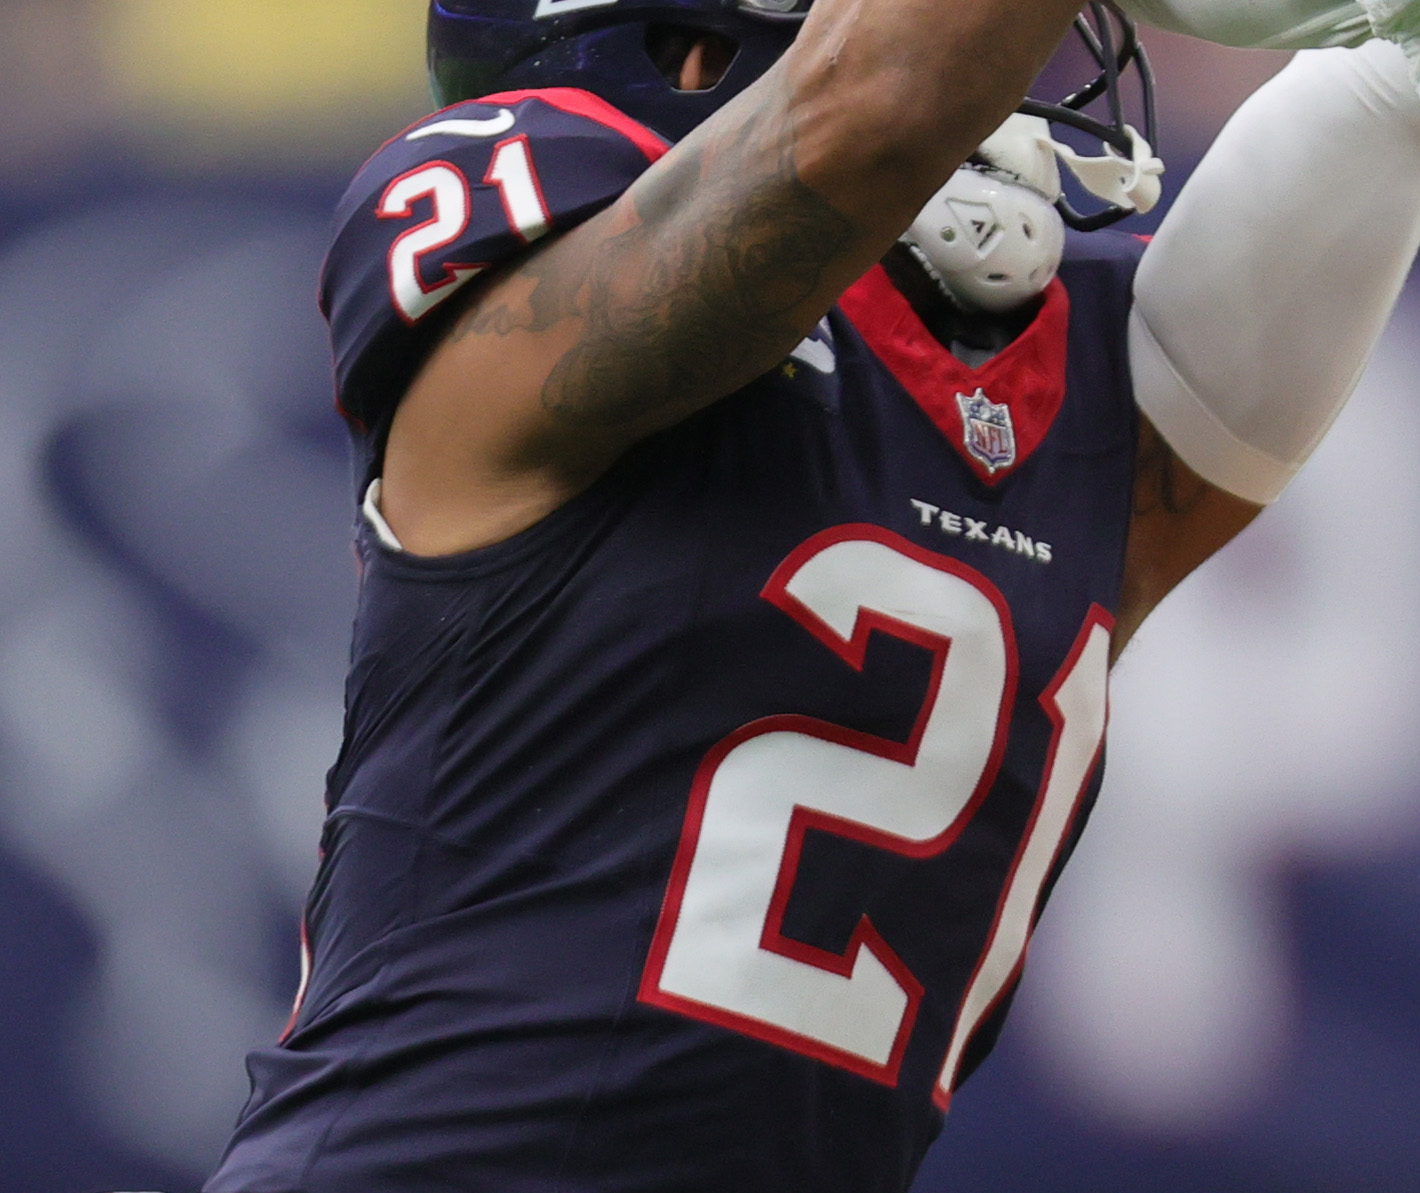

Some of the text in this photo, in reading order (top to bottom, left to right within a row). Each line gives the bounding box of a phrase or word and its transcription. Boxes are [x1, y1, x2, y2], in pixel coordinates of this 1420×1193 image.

[374, 133, 553, 327] 21
[972, 419, 1009, 456] NFL
[910, 498, 1053, 563] TEXANS
[637, 522, 1115, 1114] 21
